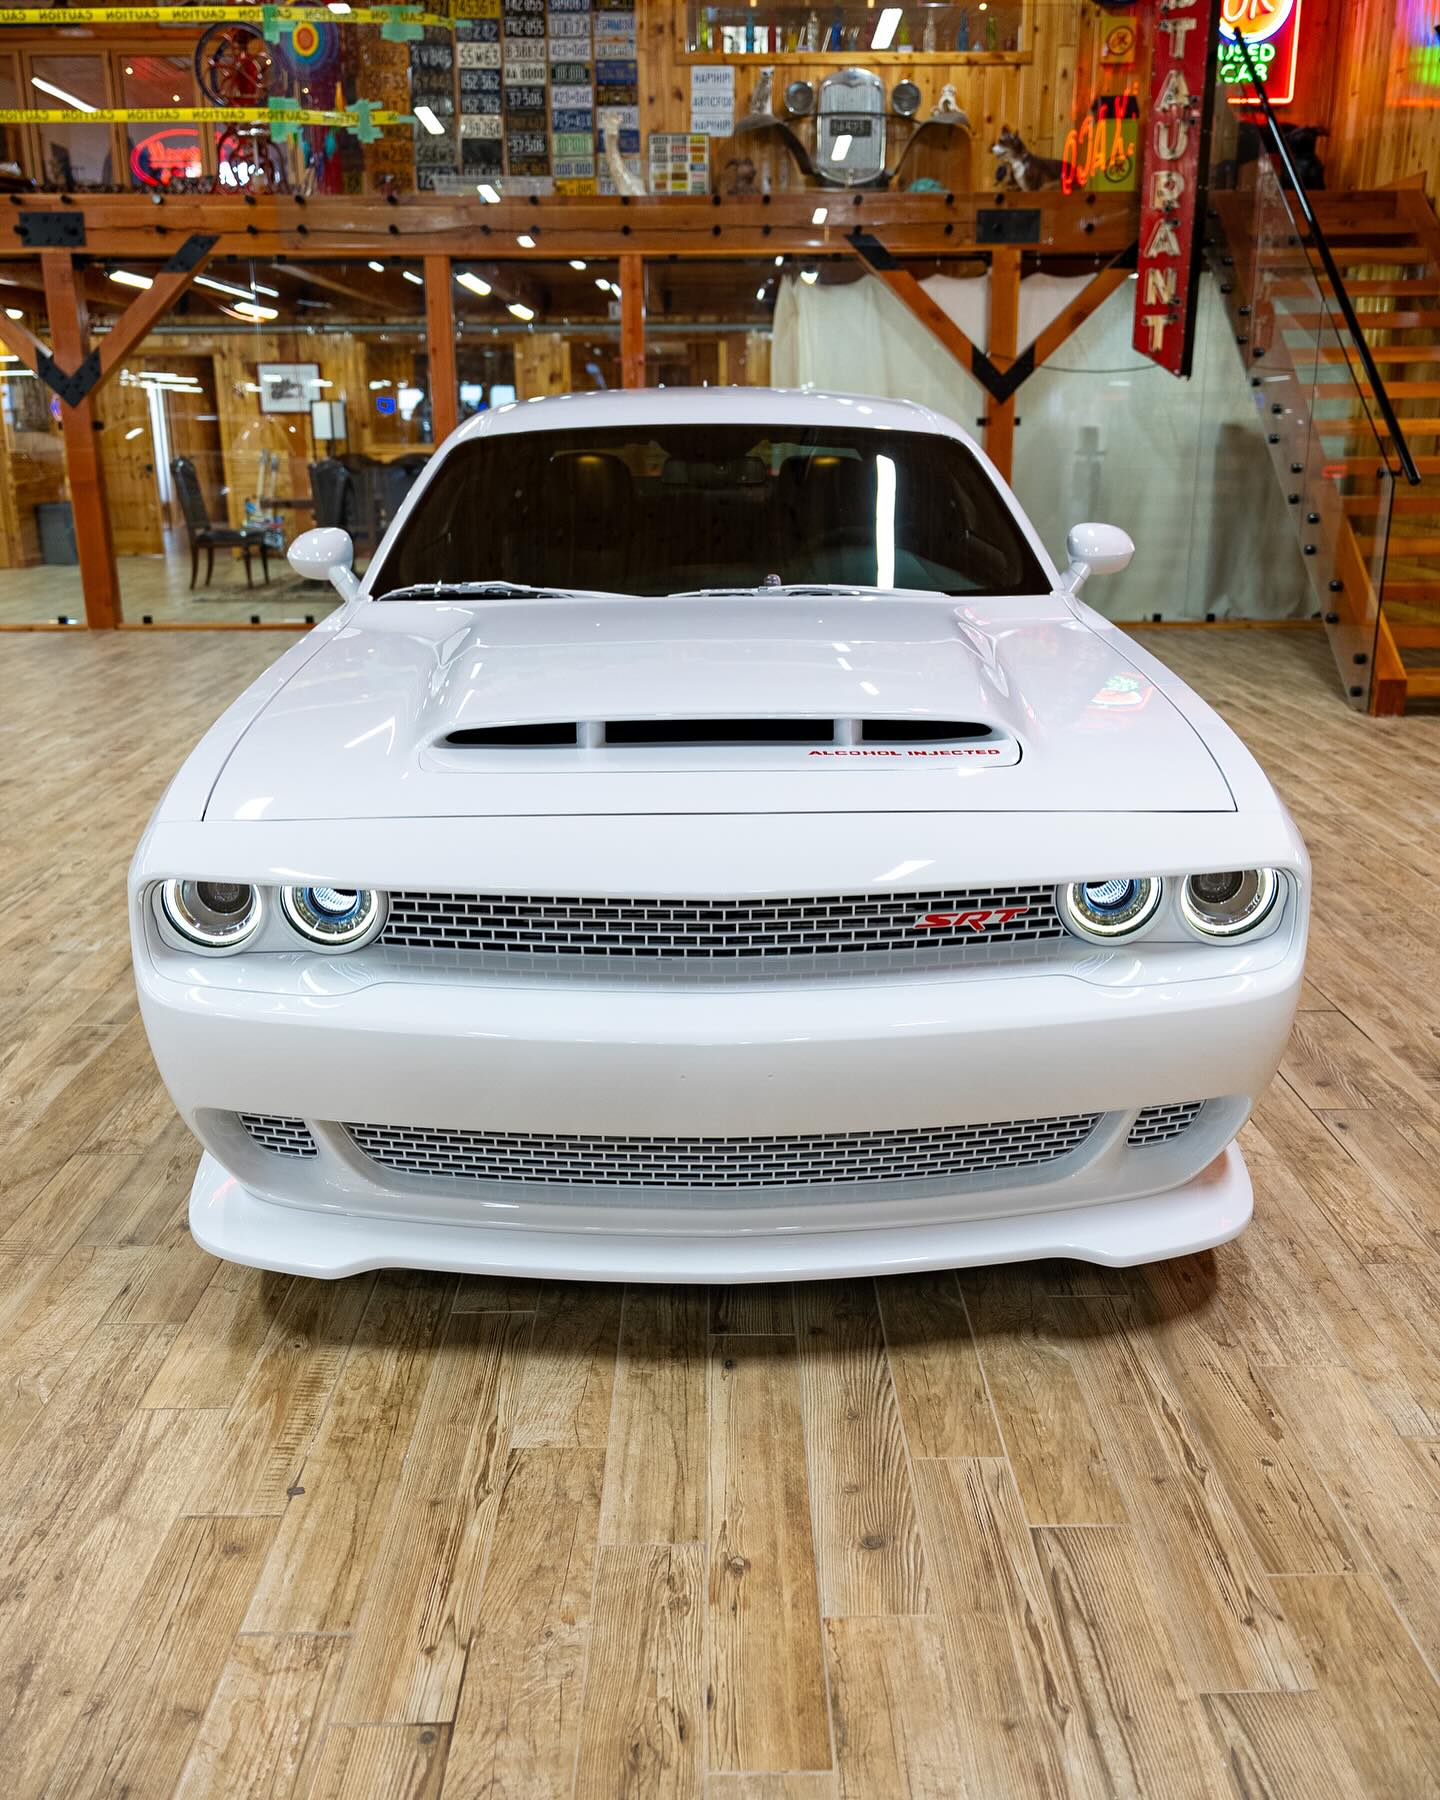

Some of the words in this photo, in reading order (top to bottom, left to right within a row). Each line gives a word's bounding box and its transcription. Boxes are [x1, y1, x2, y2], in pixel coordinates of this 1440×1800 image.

[1217, 43, 1276, 62] USED
[1220, 63, 1268, 83] CAR
[1136, 0, 1200, 352] TAURANT
[907, 748, 1001, 756] INJECTED
[913, 906, 1029, 932] SRT
